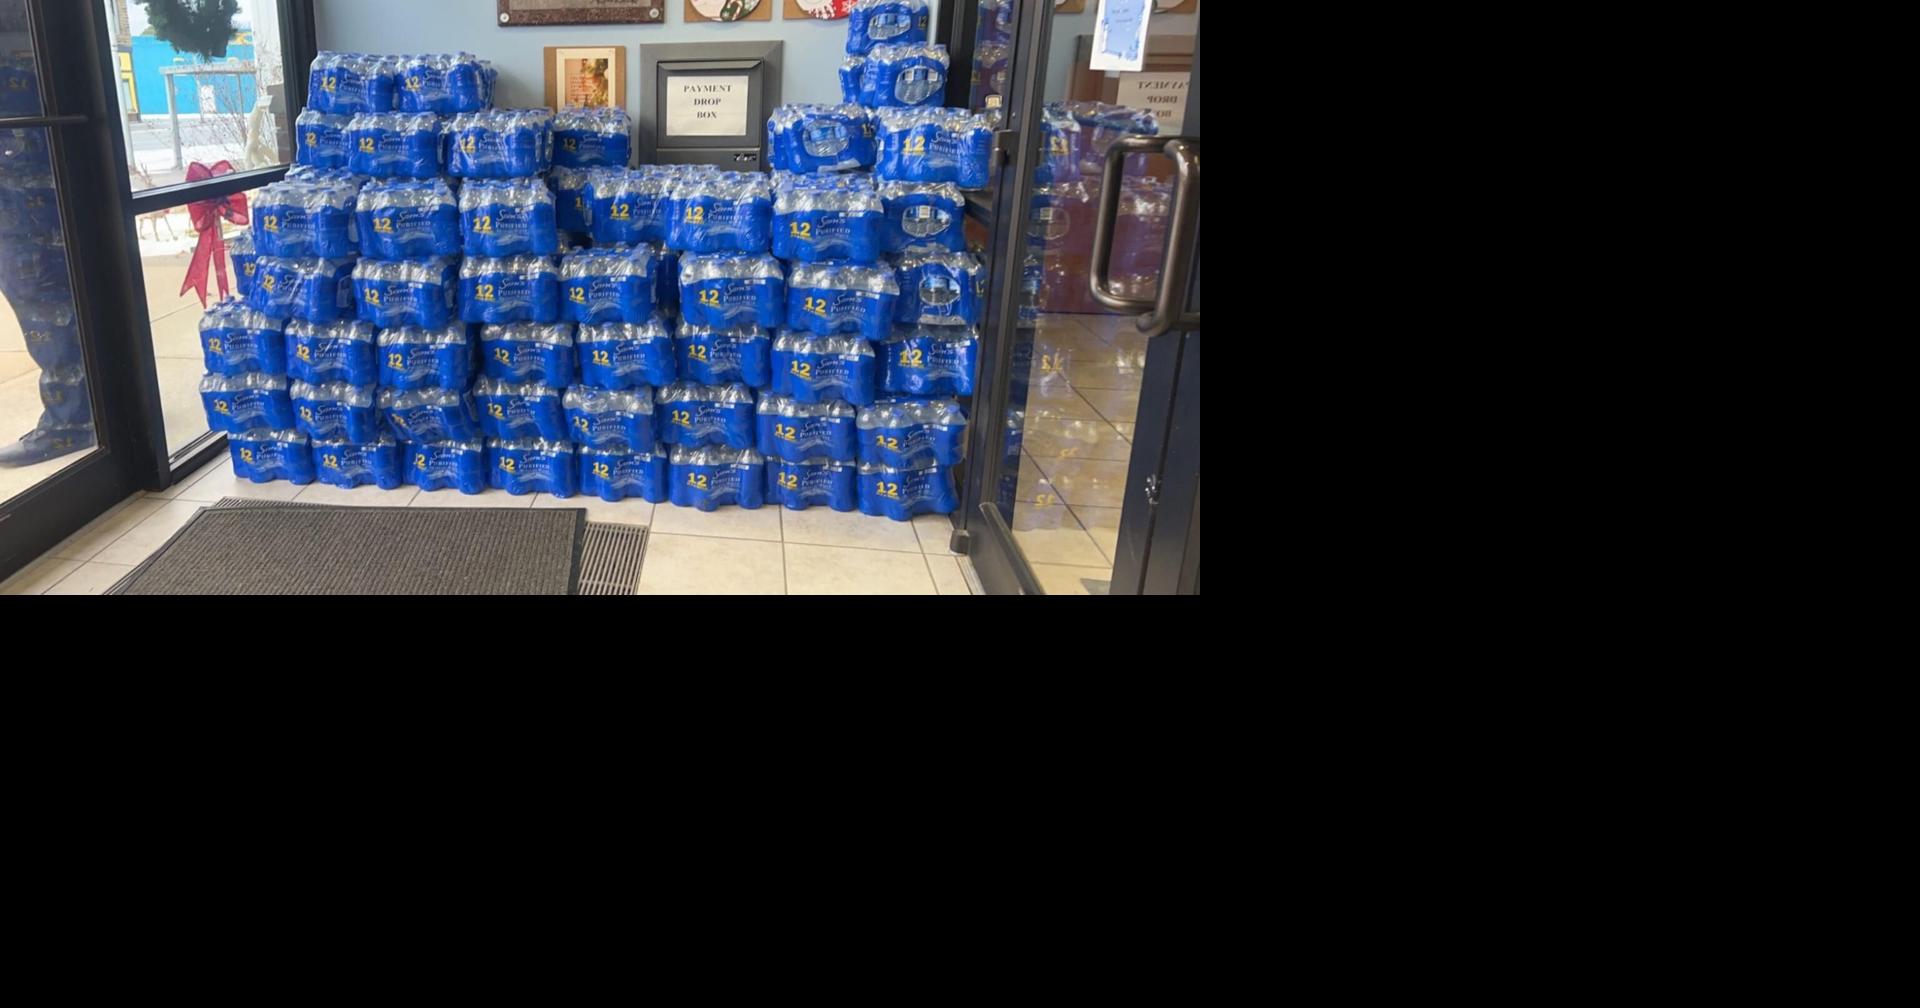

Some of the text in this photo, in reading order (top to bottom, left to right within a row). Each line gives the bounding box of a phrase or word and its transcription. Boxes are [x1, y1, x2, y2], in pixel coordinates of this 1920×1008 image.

[321, 77, 336, 91] 12
[405, 76, 421, 90] 12
[684, 85, 732, 93] PAYMENT
[360, 137, 374, 153] 12
[461, 136, 477, 153] 12
[563, 139, 577, 150] 12
[903, 136, 926, 155] 12
[611, 204, 629, 218] 12
[686, 206, 704, 221] 12
[264, 216, 278, 232] 12
[373, 218, 392, 233] 12
[473, 216, 491, 232] 12
[790, 222, 811, 238] 12
[263, 274, 275, 293] 12
[364, 288, 380, 304] 12
[475, 285, 493, 299] 12
[569, 287, 585, 301] 12
[699, 290, 719, 305] 12
[804, 297, 826, 315] 12
[209, 338, 221, 353] 12
[296, 343, 310, 361] 12
[689, 344, 706, 360] 12
[388, 353, 403, 368] 12
[495, 348, 509, 362] 12
[592, 350, 609, 364] 12
[900, 349, 922, 366] 12
[791, 360, 811, 377] 12
[214, 399, 229, 412] 12
[300, 405, 313, 421] 12
[487, 403, 503, 417] 12
[573, 416, 589, 432] 12
[672, 410, 690, 425] 12
[775, 424, 795, 440] 12
[876, 435, 898, 449] 12
[240, 448, 252, 463] 12
[323, 455, 337, 467] 12
[500, 457, 515, 471] 12
[592, 462, 609, 477] 12
[688, 473, 707, 488] 12
[778, 472, 798, 488] 12
[876, 482, 898, 497] 12
